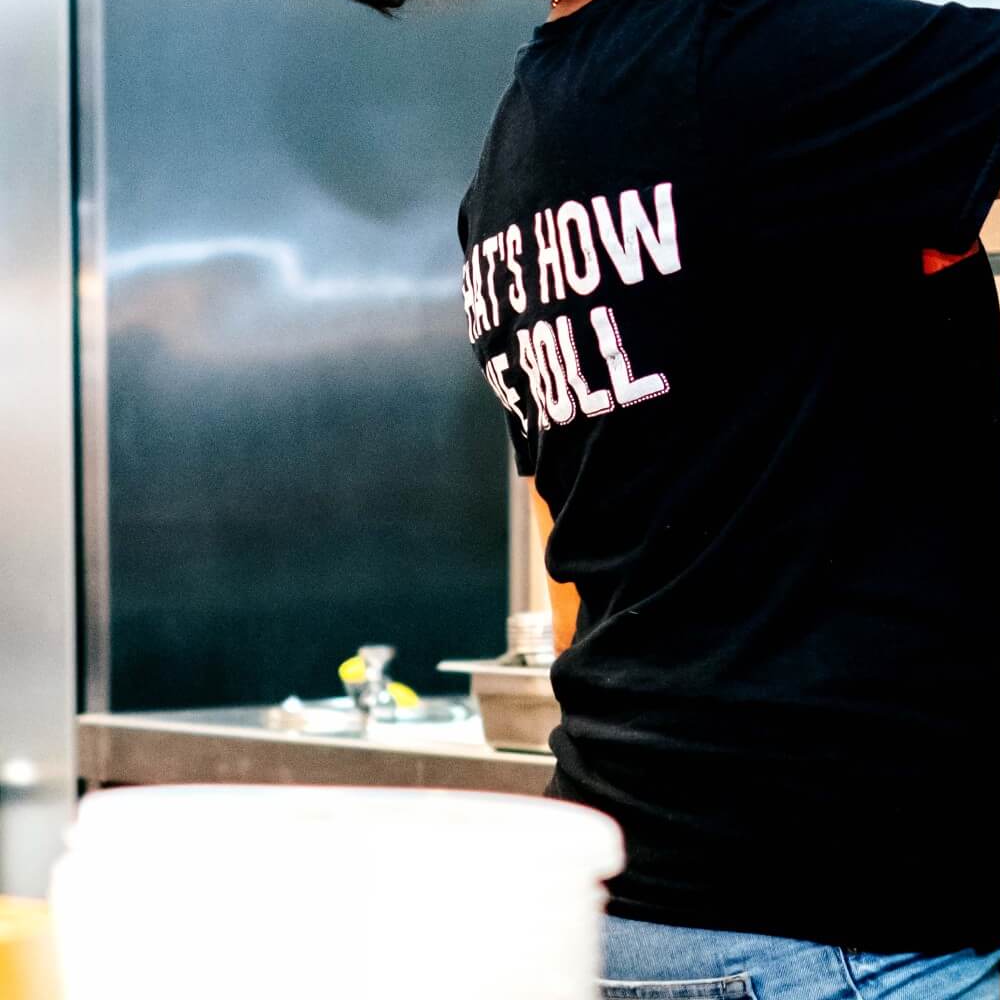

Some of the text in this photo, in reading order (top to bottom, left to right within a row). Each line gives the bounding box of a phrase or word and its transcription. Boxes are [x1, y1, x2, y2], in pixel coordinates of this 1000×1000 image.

[462, 182, 682, 344] HAT'S HOW
[516, 306, 670, 431] ROLL
